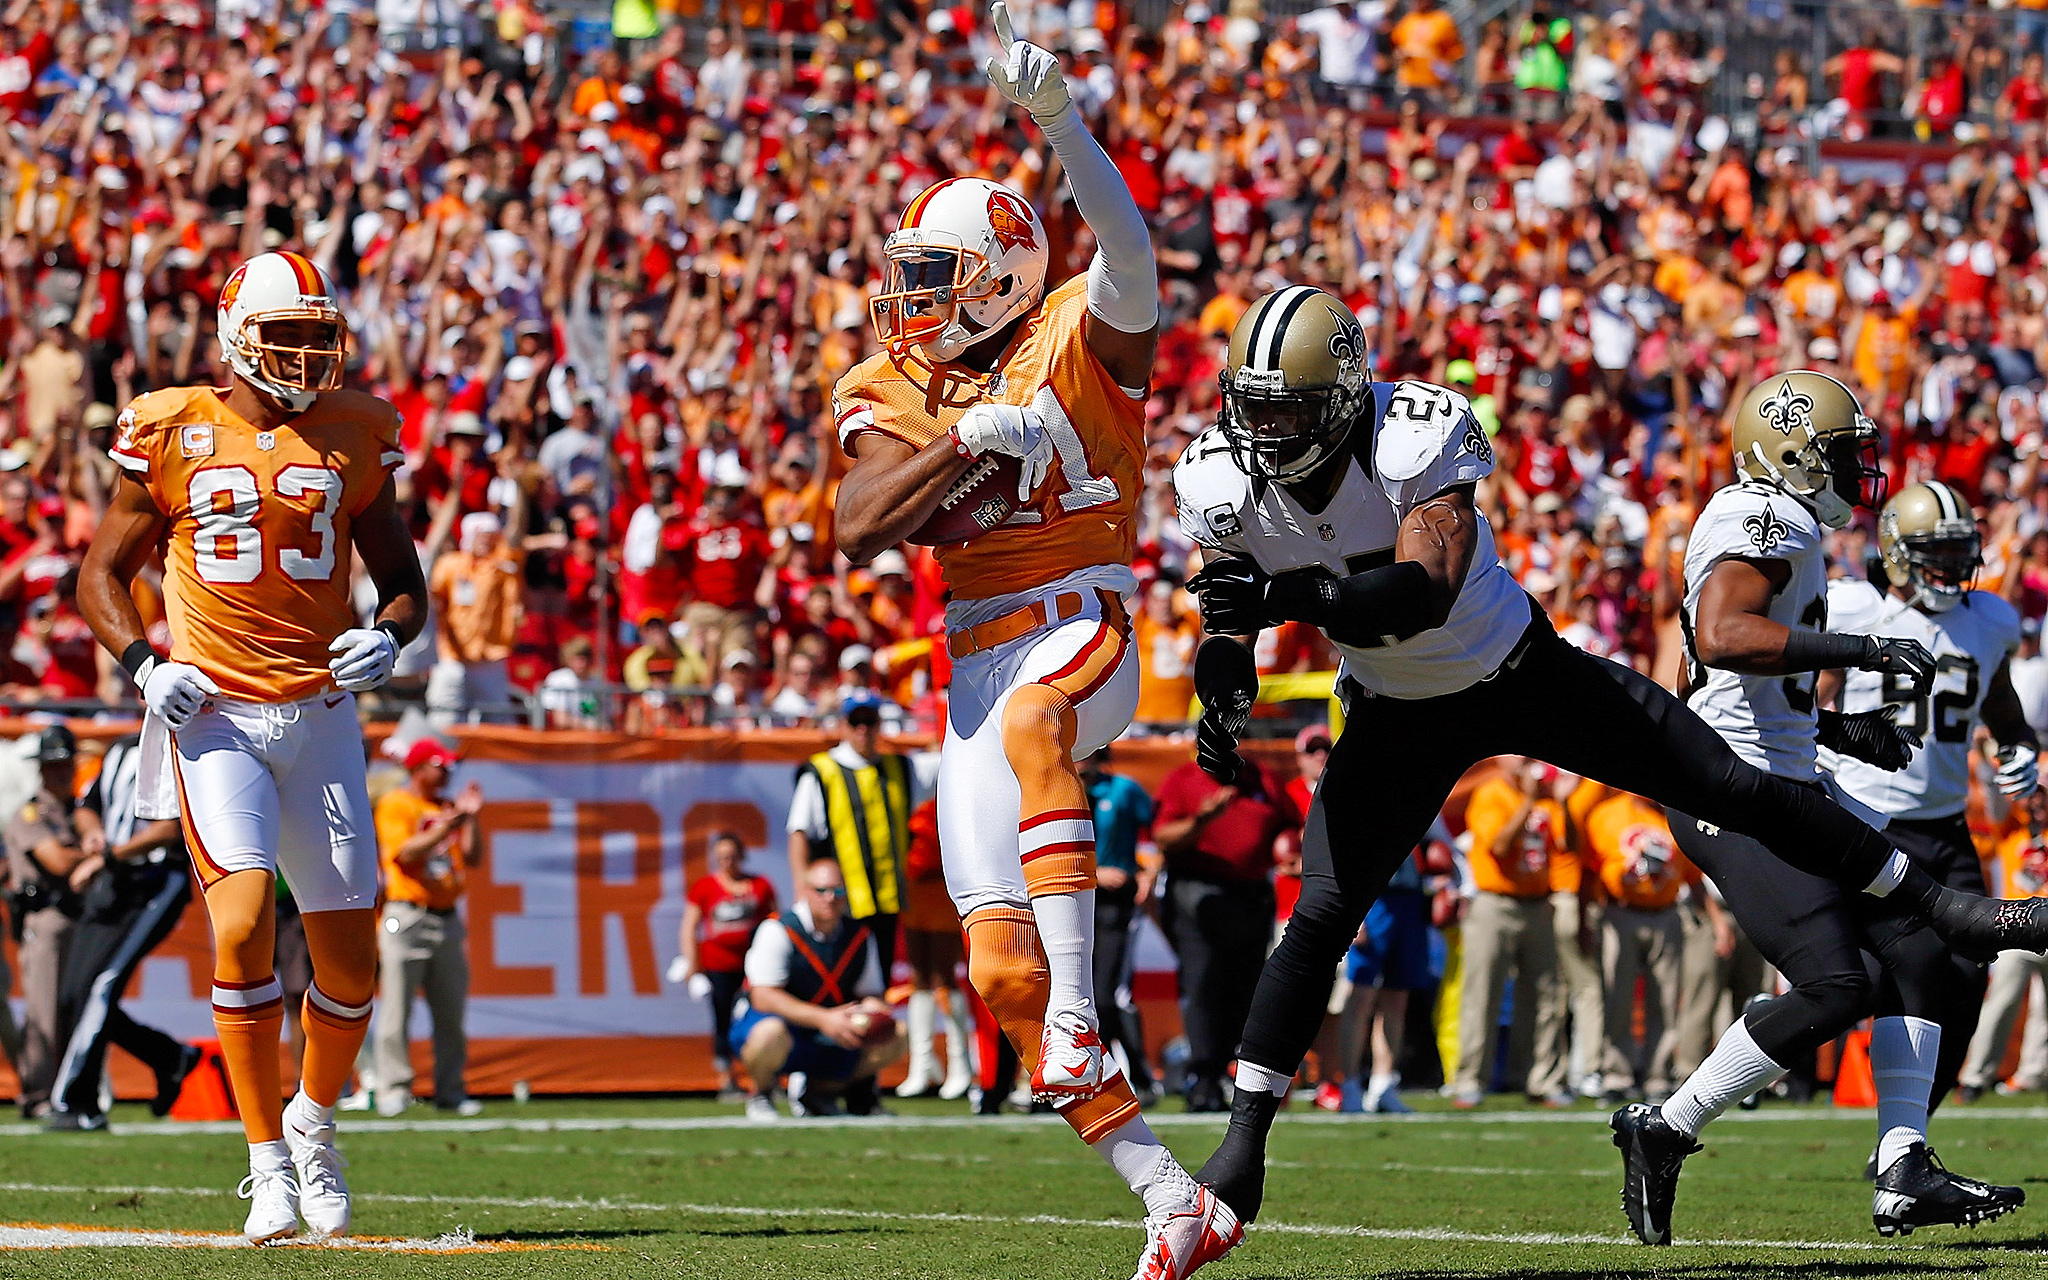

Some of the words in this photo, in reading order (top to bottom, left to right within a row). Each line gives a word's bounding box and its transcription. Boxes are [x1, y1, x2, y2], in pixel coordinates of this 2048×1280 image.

[182, 427, 211, 449] C
[187, 463, 344, 586] 83
[980, 502, 1009, 529] NFL
[1211, 507, 1235, 531] C
